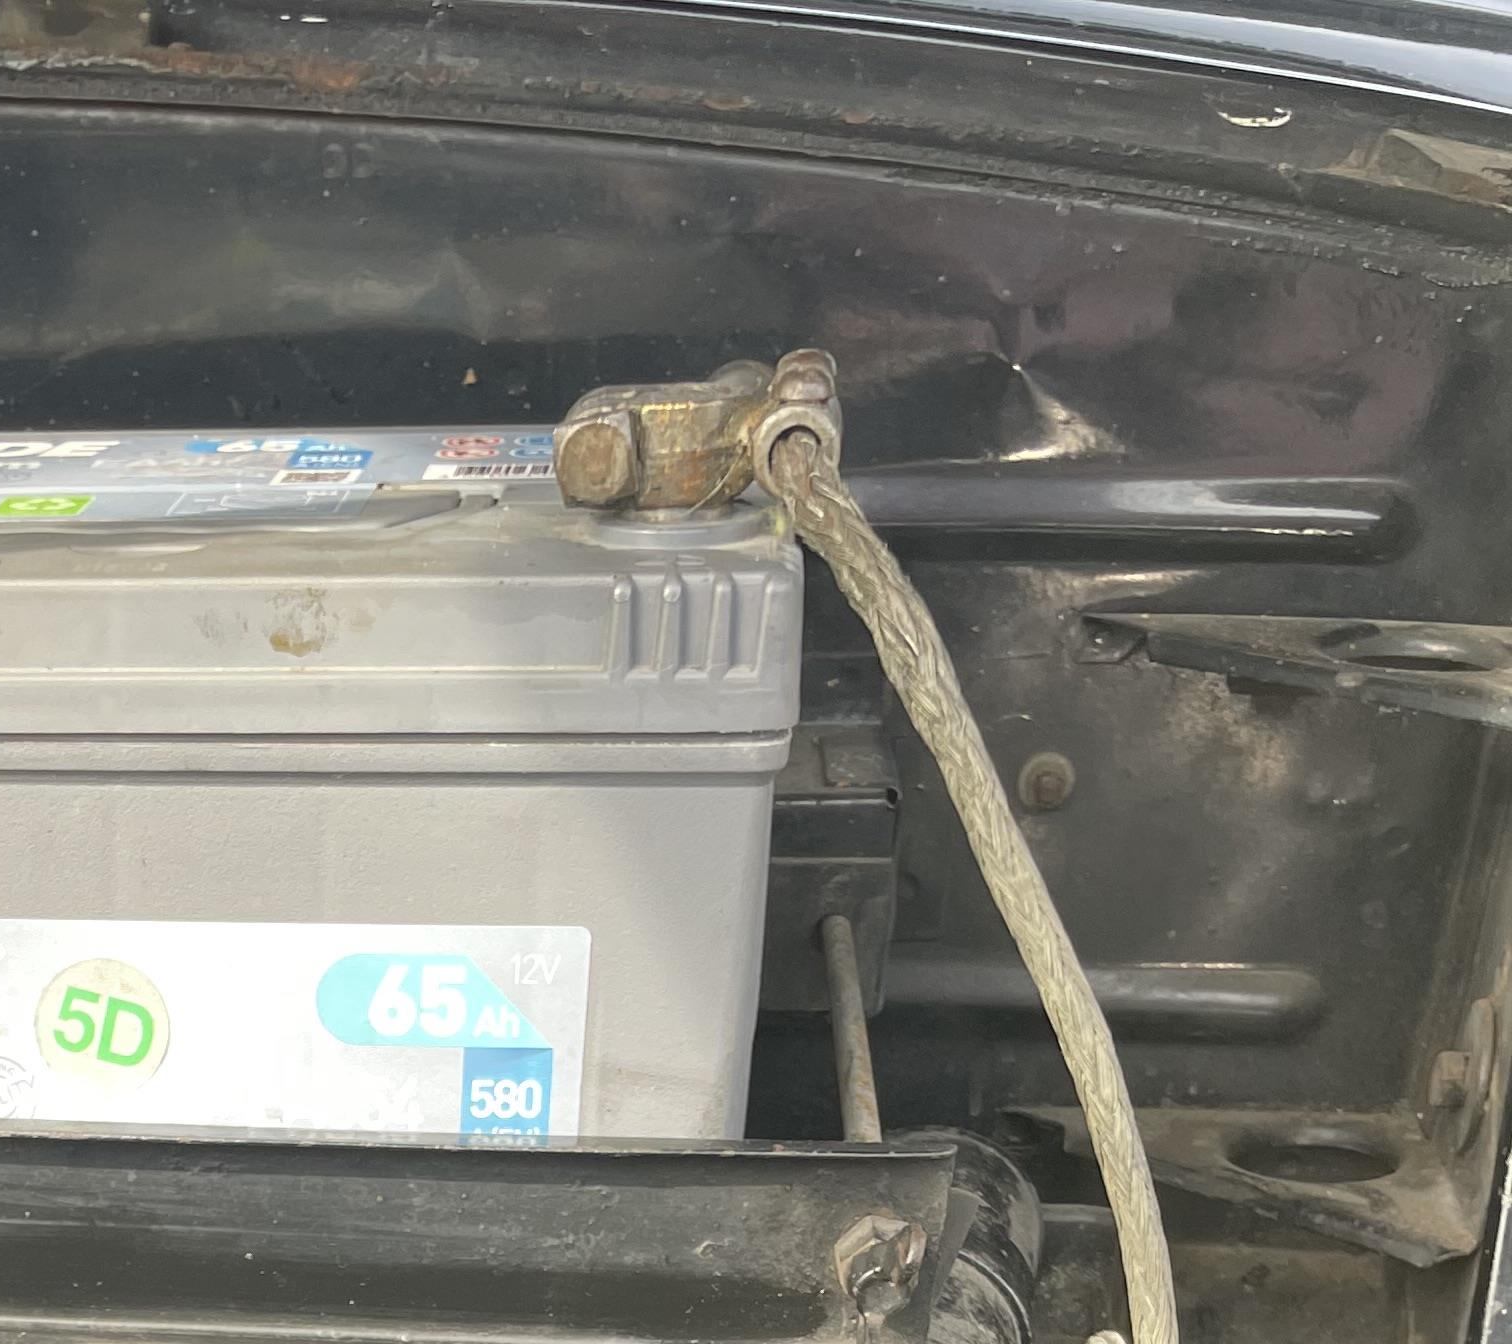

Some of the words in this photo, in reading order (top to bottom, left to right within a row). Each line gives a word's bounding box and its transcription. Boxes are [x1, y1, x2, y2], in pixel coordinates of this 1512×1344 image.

[216, 439, 301, 453] 65
[510, 954, 562, 985] 12V
[368, 963, 469, 1038] 65
[472, 1005, 520, 1039] Ah
[53, 985, 155, 1067] 5D
[469, 1079, 543, 1119] 580
